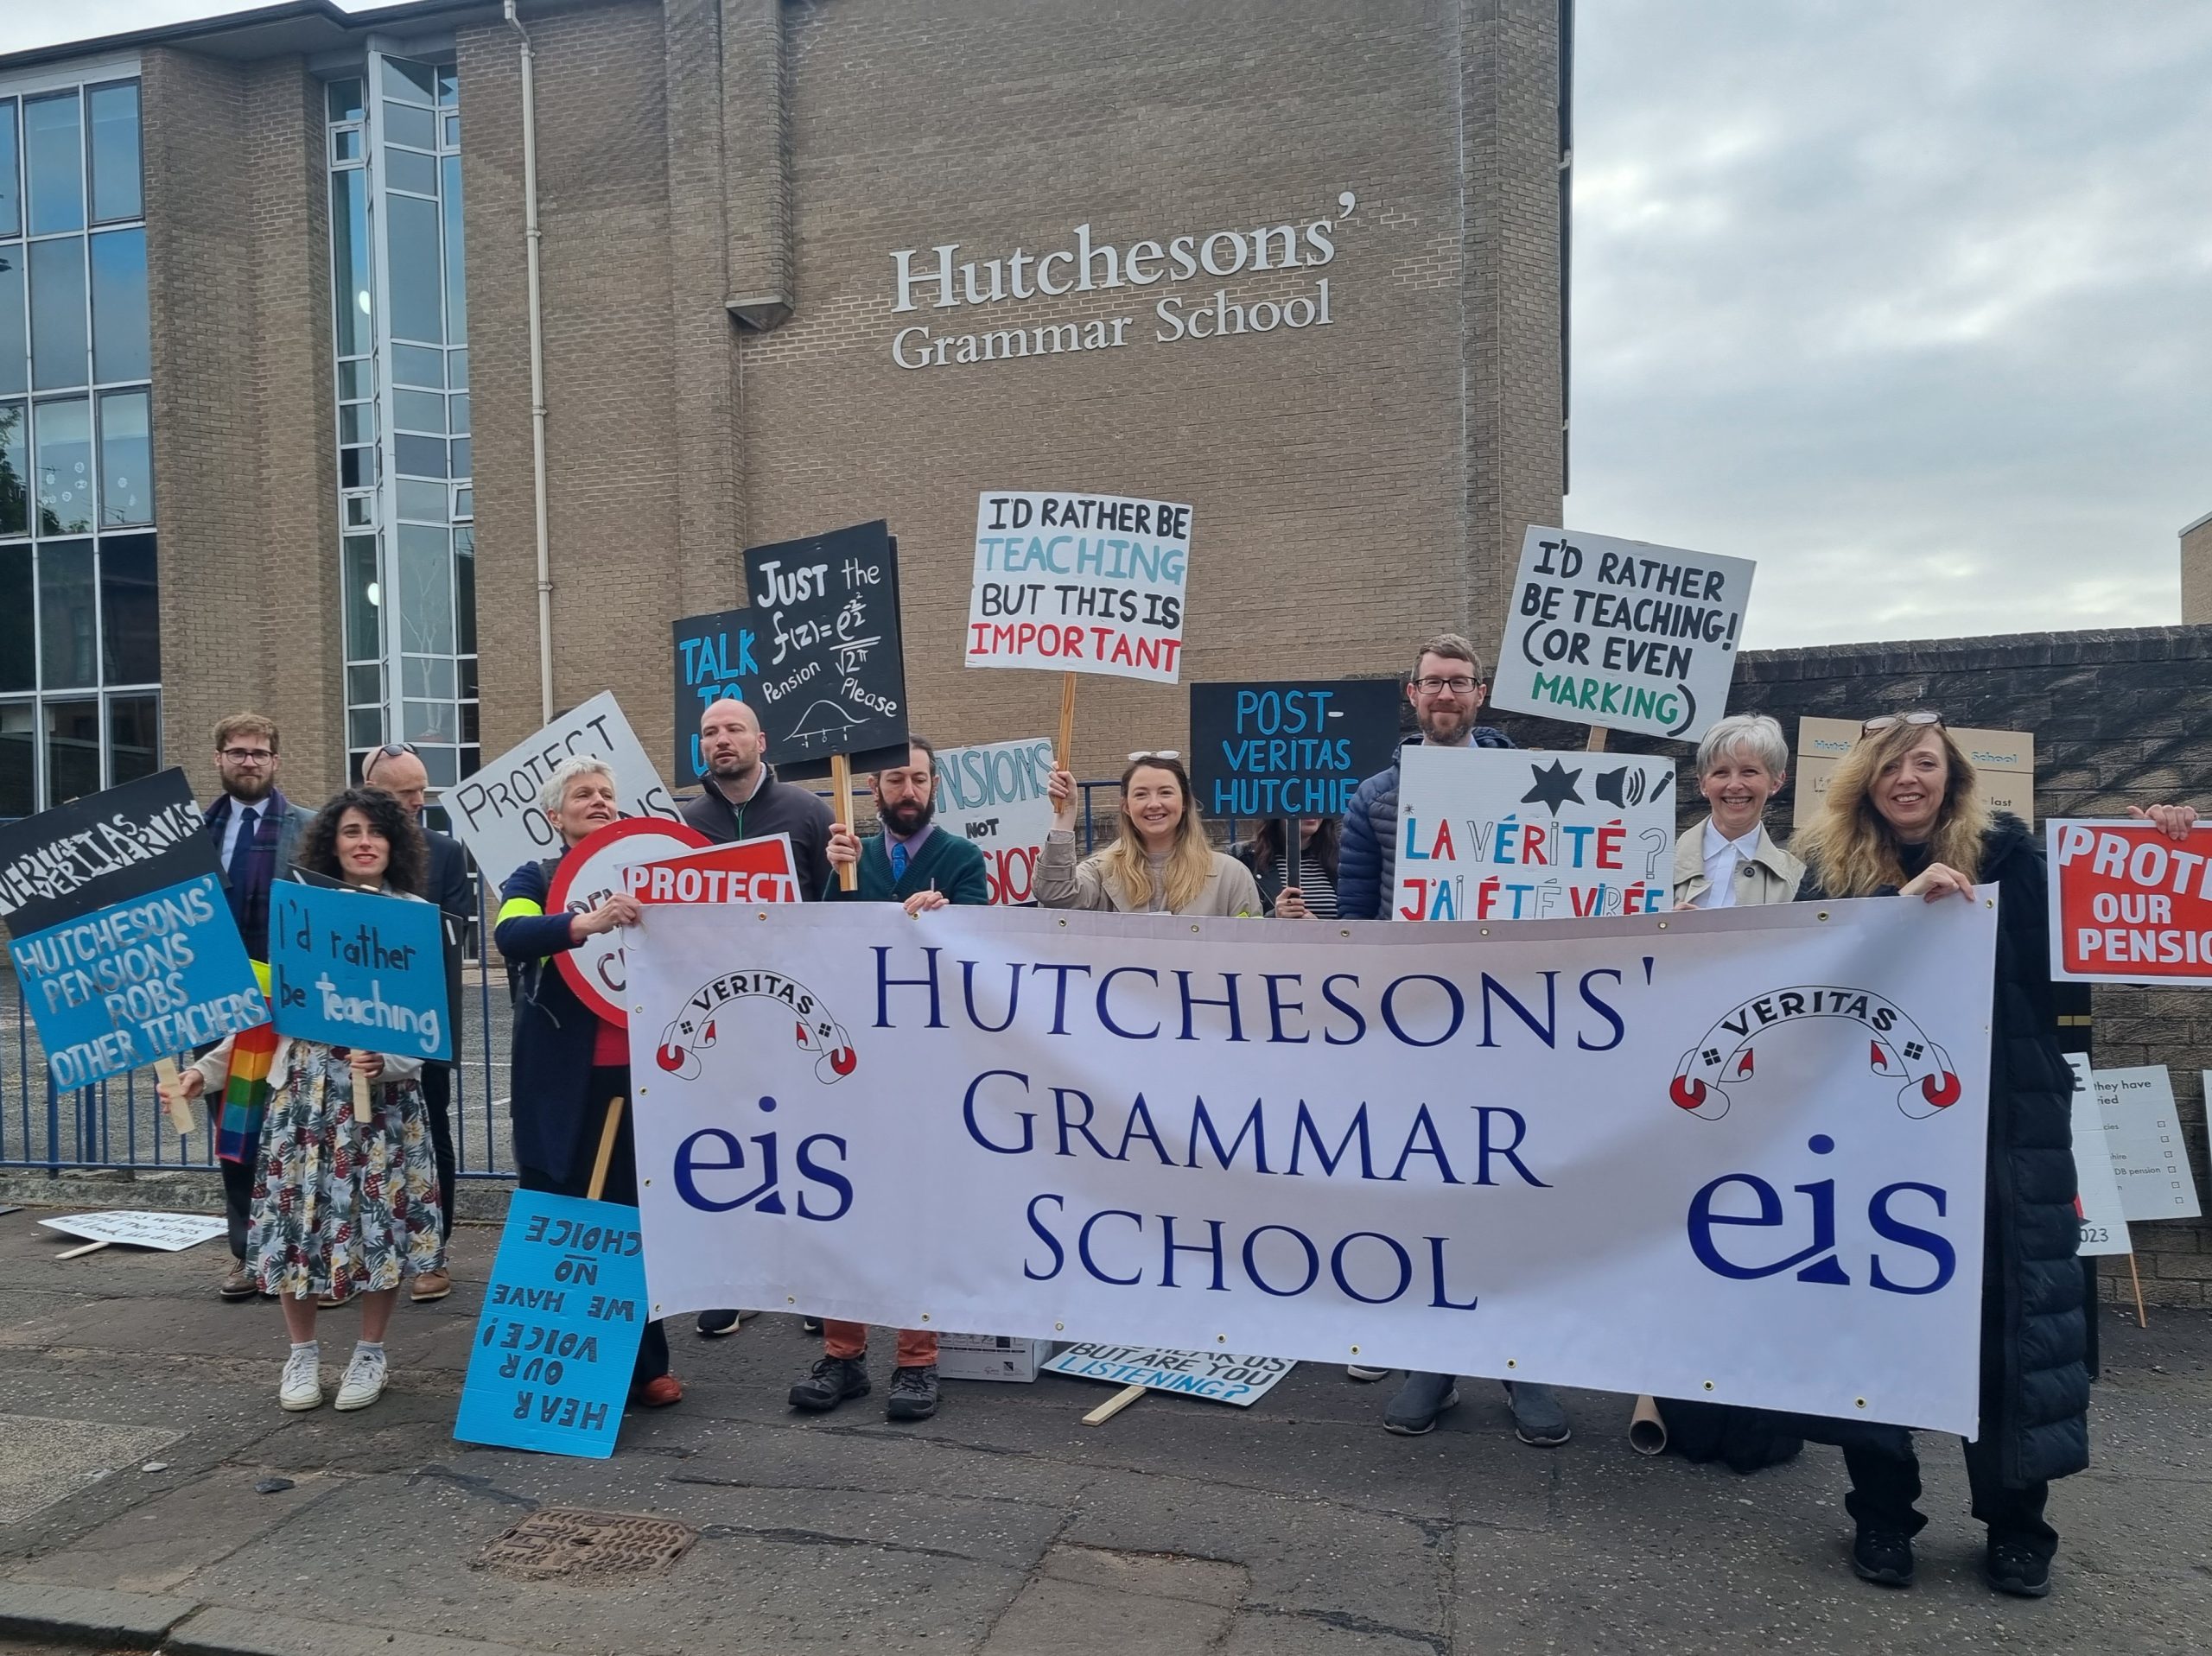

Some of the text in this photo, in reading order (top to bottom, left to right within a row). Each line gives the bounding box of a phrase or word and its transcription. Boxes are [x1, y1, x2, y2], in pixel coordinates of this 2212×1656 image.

[889, 191, 1357, 314] Hutchesons'
[891, 277, 1334, 370] Grammar School
[988, 498, 1190, 540] I'D RATHER BE
[757, 557, 881, 608] JUST the
[979, 536, 1185, 585] TEACHING
[1532, 538, 1726, 602] I'D RATHER
[982, 583, 1180, 630] BUT THIS IS
[1520, 583, 1738, 651] BE TEACHING!
[679, 629, 759, 686] TALK
[969, 623, 1181, 672] IMPORTANT
[1522, 619, 1693, 680] (OR EVEN
[762, 662, 898, 718] Pension Please
[1237, 690, 1344, 735] POST-
[1530, 671, 1696, 738] MARKING)
[1222, 739, 1351, 773] VERITAS
[1814, 739, 1851, 752] Hutch
[1971, 752, 2018, 765] School
[1991, 796, 2012, 807] last
[965, 817, 1000, 839] NOT
[1405, 817, 1457, 861] LA
[1639, 828, 1667, 879] ?
[626, 866, 792, 903] PROTECT
[1477, 875, 1562, 919] ÉTÉ
[15, 878, 214, 982] HUTCHESONS'
[2093, 893, 2171, 924] OUR
[279, 899, 416, 971] I'd rather
[42, 933, 195, 1014] PENSIONS
[691, 974, 815, 1016] VERITAS
[105, 972, 189, 1030] ROBS
[278, 964, 440, 1053] be teaching
[868, 946, 1656, 1051] HUTCHESONS'
[1721, 991, 1898, 1037] VERITAS
[51, 987, 266, 1086] OTHER TEACHERS
[2121, 1080, 2152, 1090] have
[963, 1069, 1554, 1189] GRAMMAR
[673, 1095, 855, 1222] eis
[2129, 1166, 2161, 1177] pension
[524, 1215, 643, 1256] CHOICE
[1687, 1133, 1957, 1296] eis
[2080, 1228, 2109, 1243] 023
[554, 1260, 598, 1285] NO
[1024, 1193, 1478, 1311] SCHOOL
[492, 1284, 635, 1322] WE HAVE
[483, 1317, 598, 1362] VOICE!
[499, 1353, 563, 1386] OUR
[1057, 1355, 1251, 1400] LISTENING?
[1070, 1342, 1140, 1362] BUT
[1128, 1354, 1201, 1372] ARE
[1206, 1362, 1275, 1386] YOU
[513, 1391, 609, 1431] HEAR
